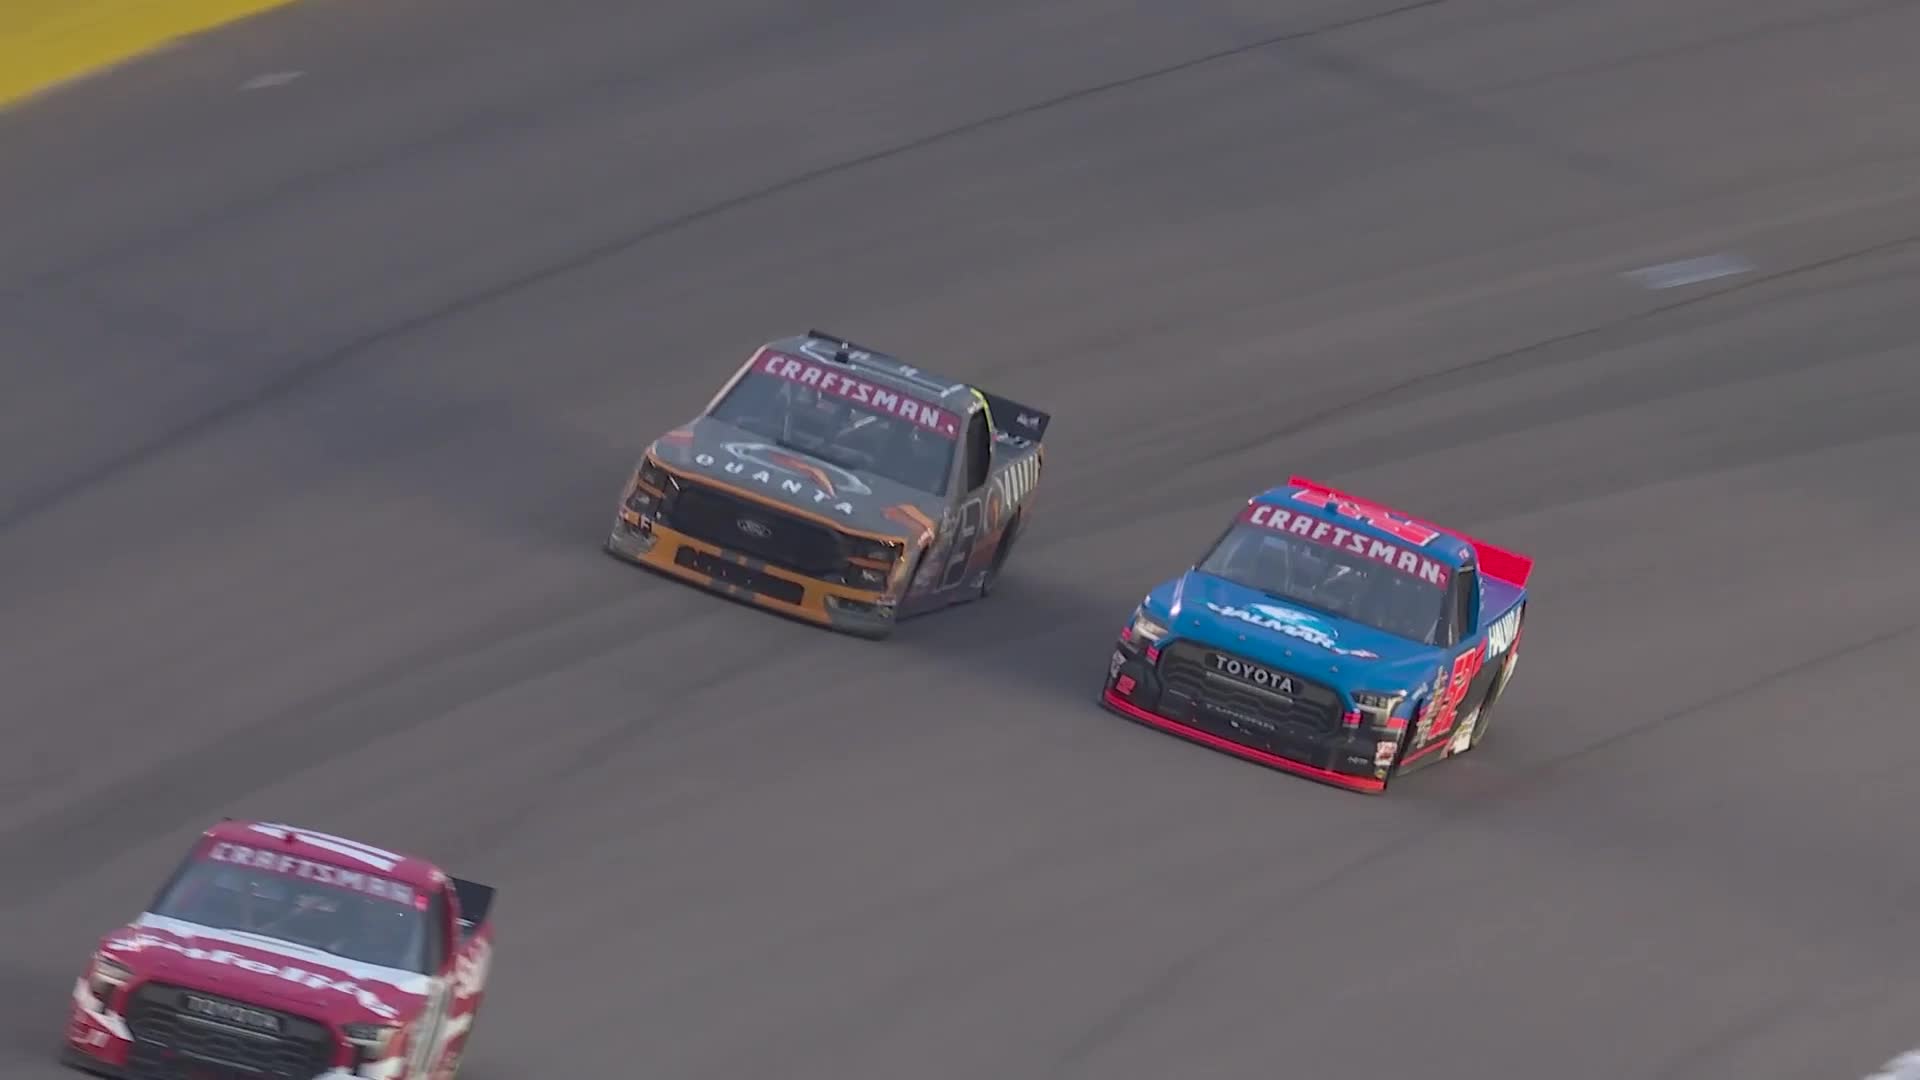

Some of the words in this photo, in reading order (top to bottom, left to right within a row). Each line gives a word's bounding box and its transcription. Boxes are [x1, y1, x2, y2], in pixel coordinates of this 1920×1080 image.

[764, 355, 939, 429] CRAFTSMAN
[1250, 504, 1442, 585] CRAFTSMAN
[1215, 655, 1294, 693] TOYOTA
